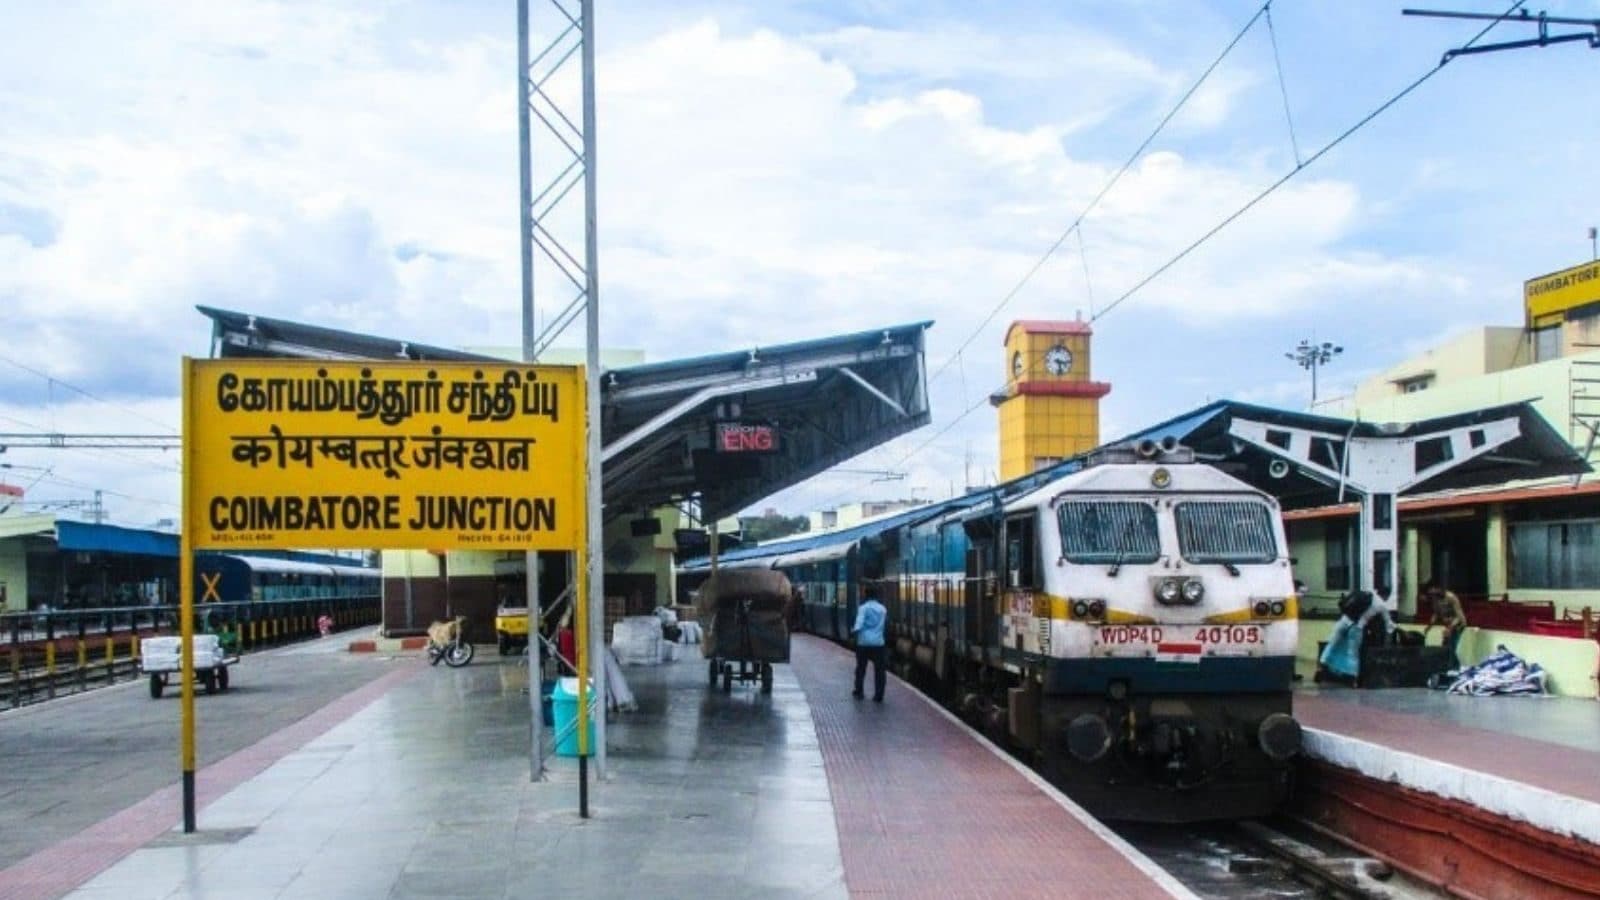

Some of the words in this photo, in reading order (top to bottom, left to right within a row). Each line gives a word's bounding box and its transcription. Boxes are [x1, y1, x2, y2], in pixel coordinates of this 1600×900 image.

[218, 368, 443, 425] கோயம்பத்தூர்
[448, 370, 559, 422] சந்திப்பு
[231, 425, 409, 479] कोयम्बत्तूर
[411, 426, 536, 471] जंक्शन
[725, 431, 771, 451] ENG
[209, 496, 401, 531] COIMBATORE
[409, 496, 555, 531] JUNCTION
[200, 573, 221, 603] X
[1195, 627, 1259, 644] 40105
